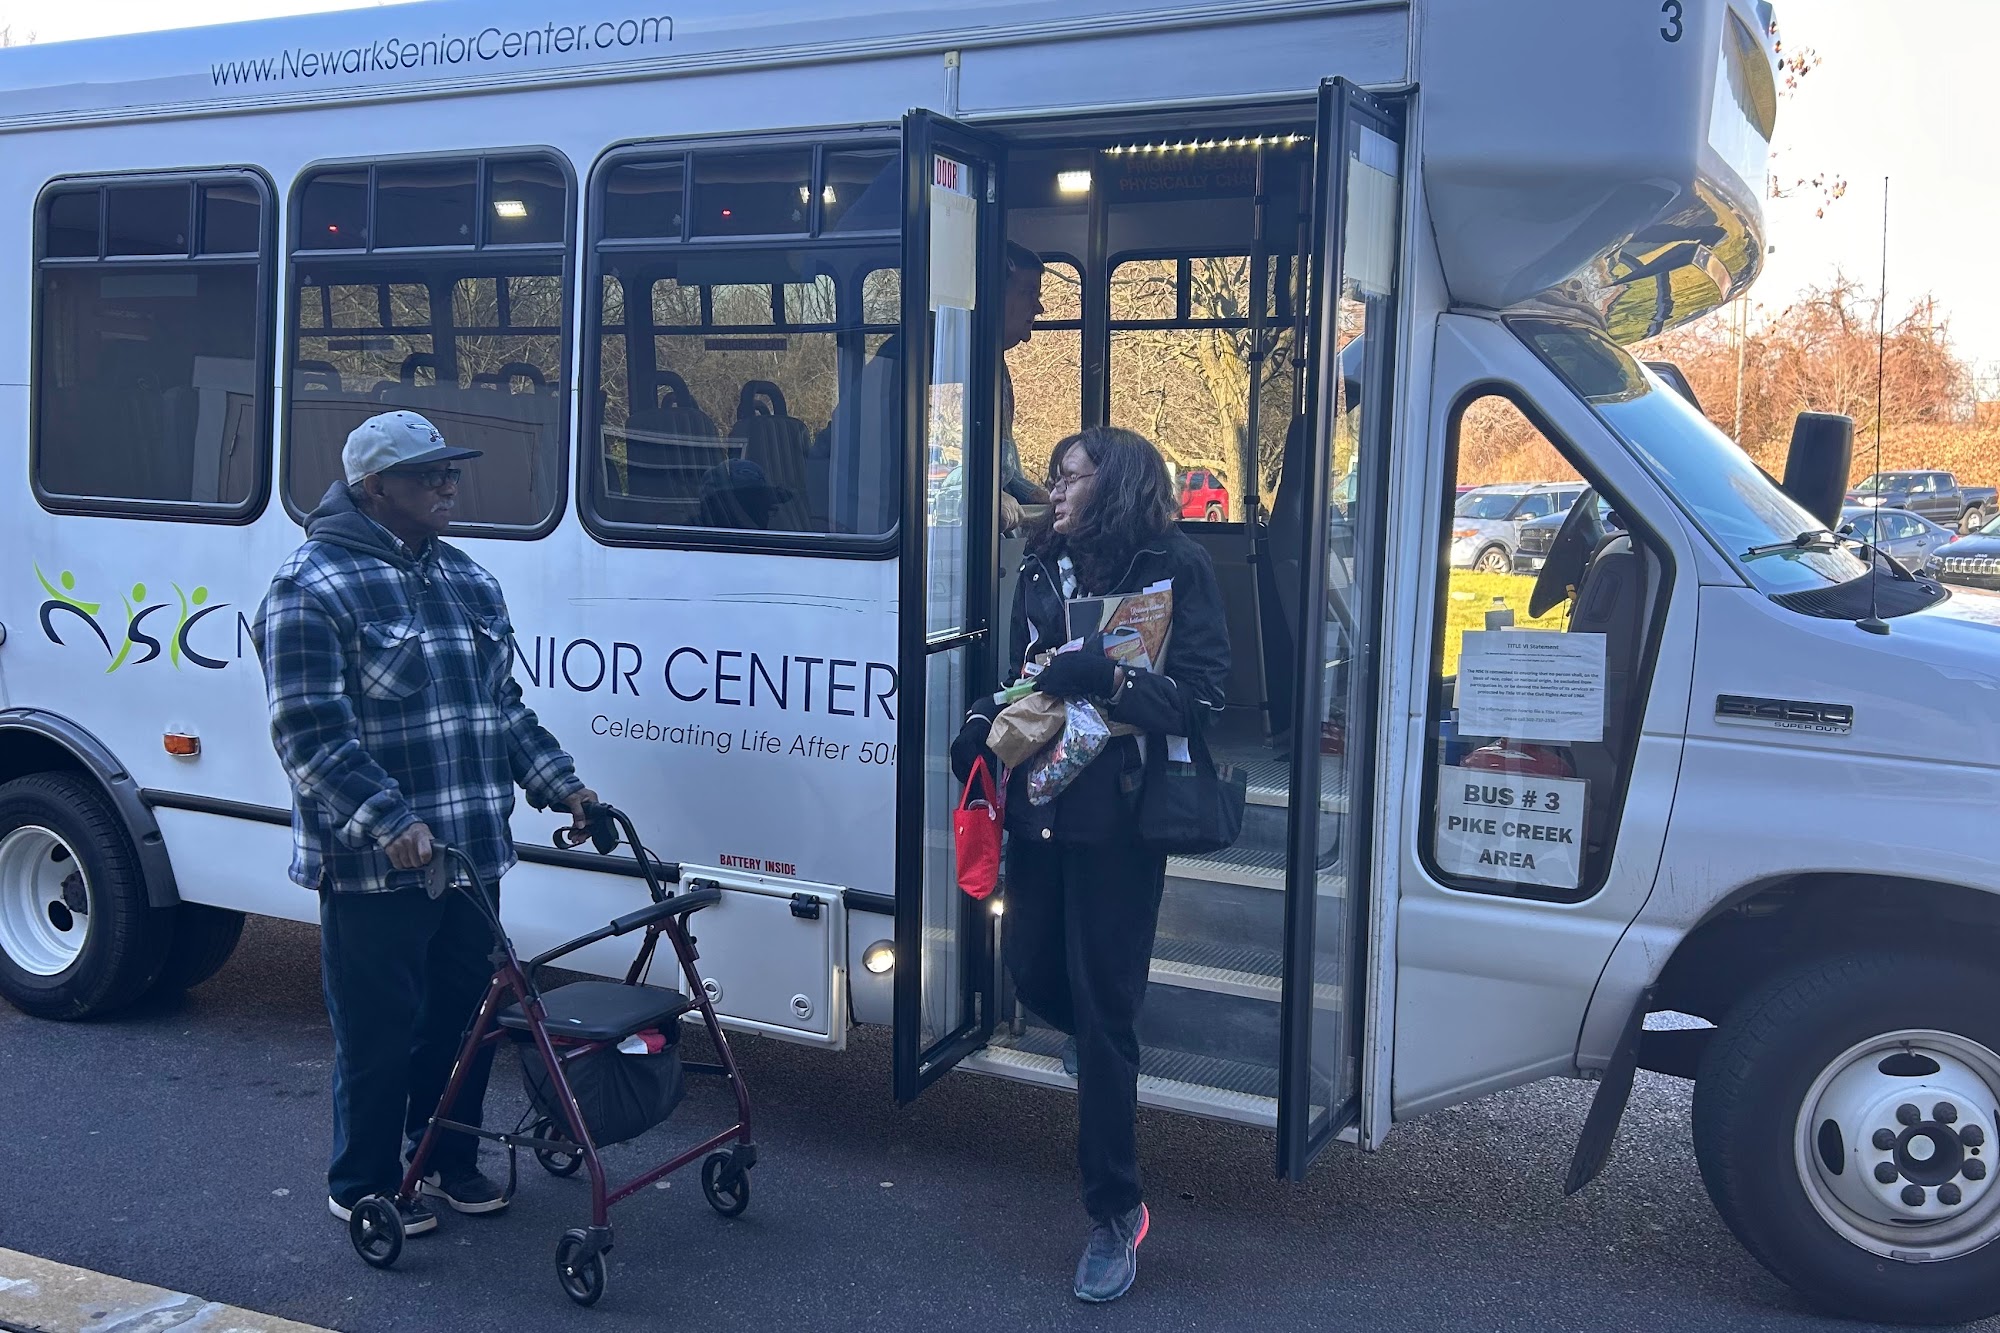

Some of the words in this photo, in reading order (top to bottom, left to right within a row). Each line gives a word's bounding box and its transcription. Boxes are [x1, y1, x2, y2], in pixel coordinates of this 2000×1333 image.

[1660, 0, 1682, 42] 3
[211, 15, 674, 87] www.NewarkSeniorCenter.com
[936, 158, 958, 191] DOOR
[1202, 154, 1256, 170] SEATIN
[513, 636, 643, 696] NIOR
[664, 646, 898, 720] CENTER
[591, 714, 732, 754] Celebrating
[741, 729, 781, 754] Life
[789, 734, 849, 761] After
[858, 742, 896, 766] 50!
[1774, 722, 1812, 730] SUPER
[1464, 784, 1514, 806] BUS
[1522, 789, 1537, 808] #
[1545, 792, 1560, 810] 3
[1448, 816, 1496, 835] PIKE
[1502, 821, 1573, 844] CREEK
[720, 854, 761, 872] BATTERY
[765, 859, 796, 876] INSIDE
[1479, 849, 1536, 870] AREA
